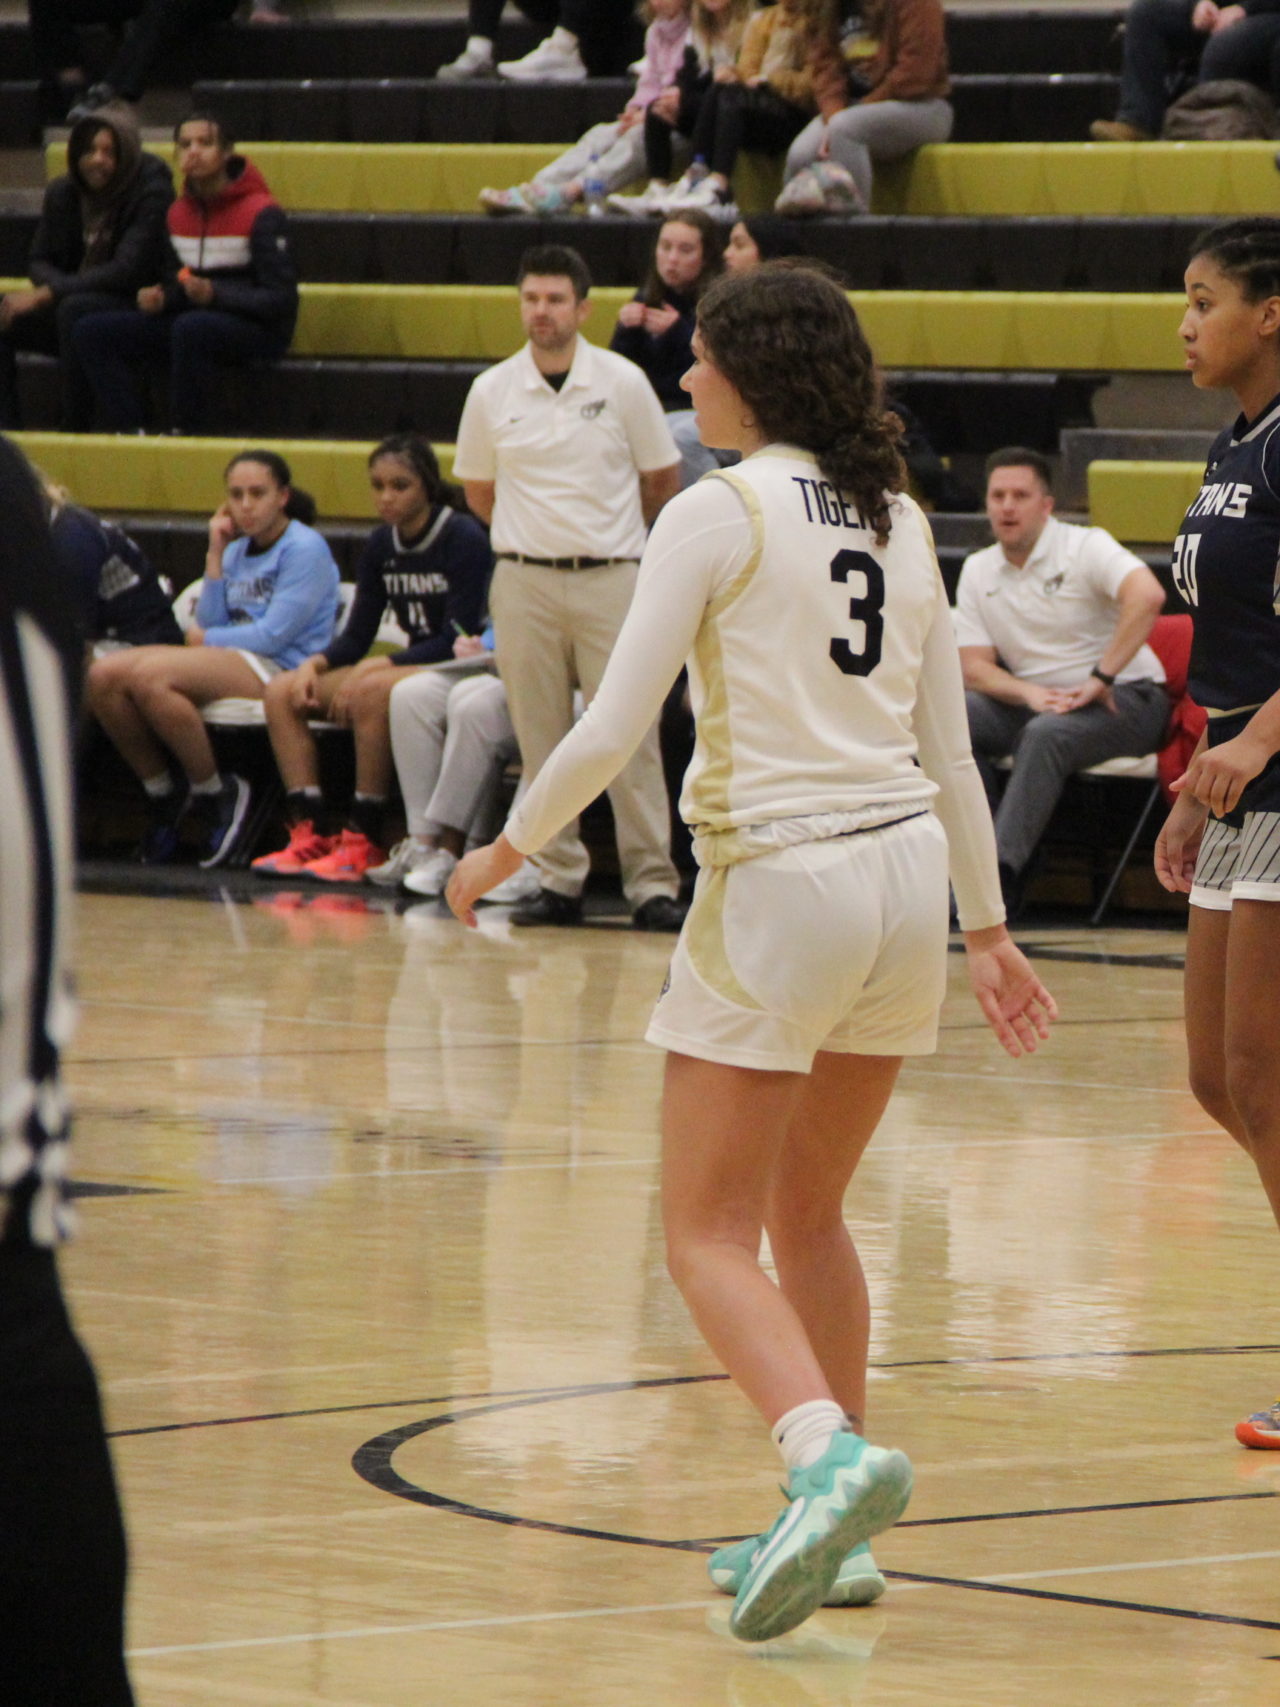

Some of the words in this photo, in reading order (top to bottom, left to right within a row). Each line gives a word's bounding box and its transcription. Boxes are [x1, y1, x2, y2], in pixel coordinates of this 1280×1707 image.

[382, 572, 450, 595] TITANS
[1171, 533, 1202, 607] 20
[829, 548, 885, 677] 3
